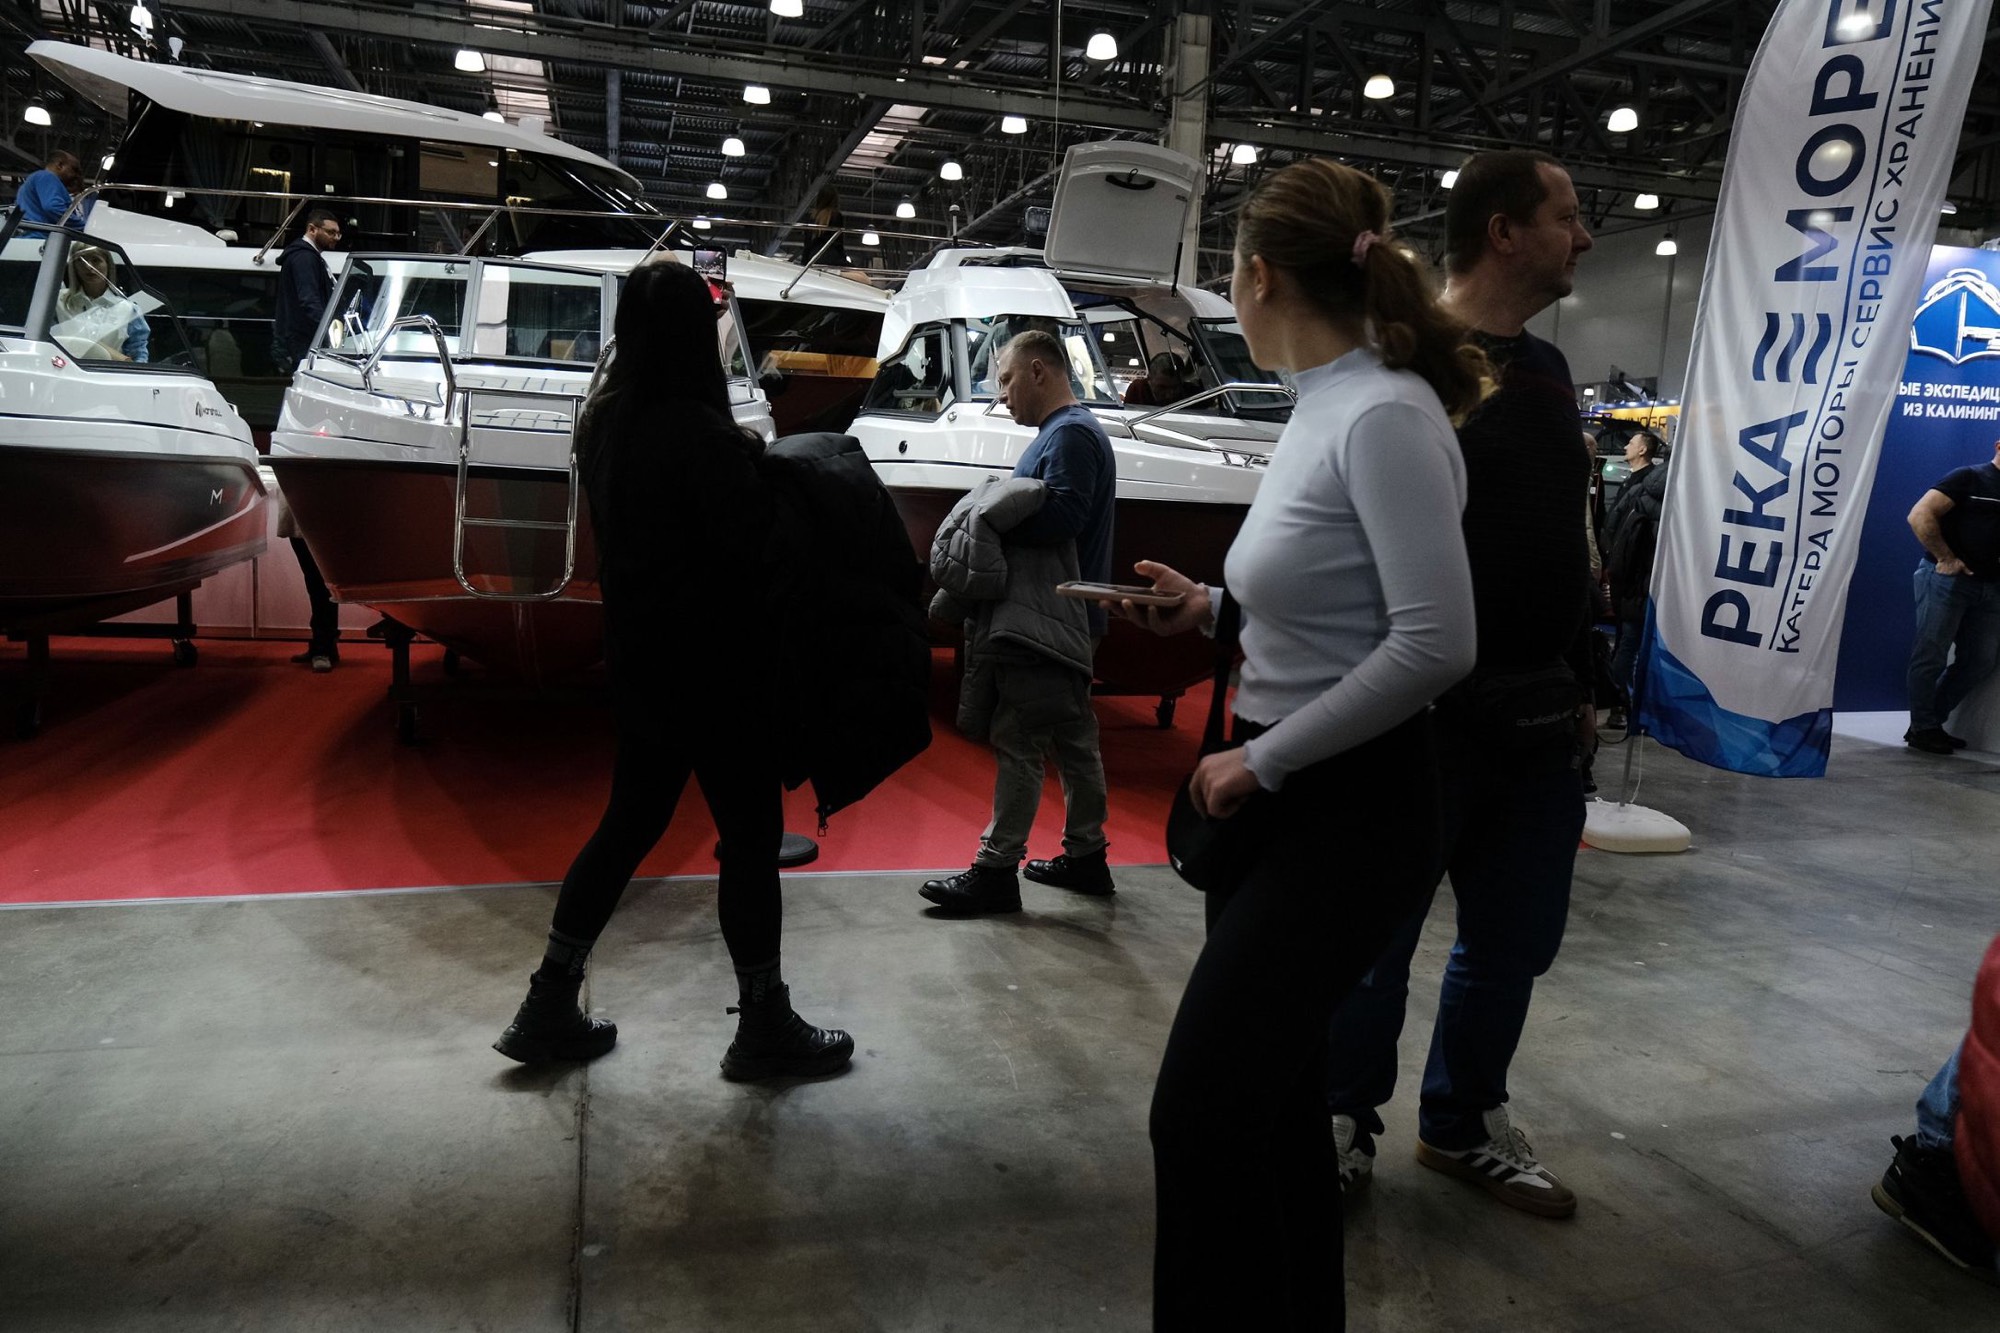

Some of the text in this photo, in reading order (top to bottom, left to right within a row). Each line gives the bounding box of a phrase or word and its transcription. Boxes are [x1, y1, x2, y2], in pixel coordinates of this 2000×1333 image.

[1701, 0, 1897, 648] РЕКА МОРЕ
[1776, 528, 1834, 653] КАТЕРА
[1810, 360, 1859, 517] МОТОРЫ
[1851, 199, 1899, 349] СЕРВИС
[1897, 381, 2000, 403] ЫЕ ЭКСПЕДИЦ
[1903, 402, 2000, 421] ИЗ КАЛИНИНГ
